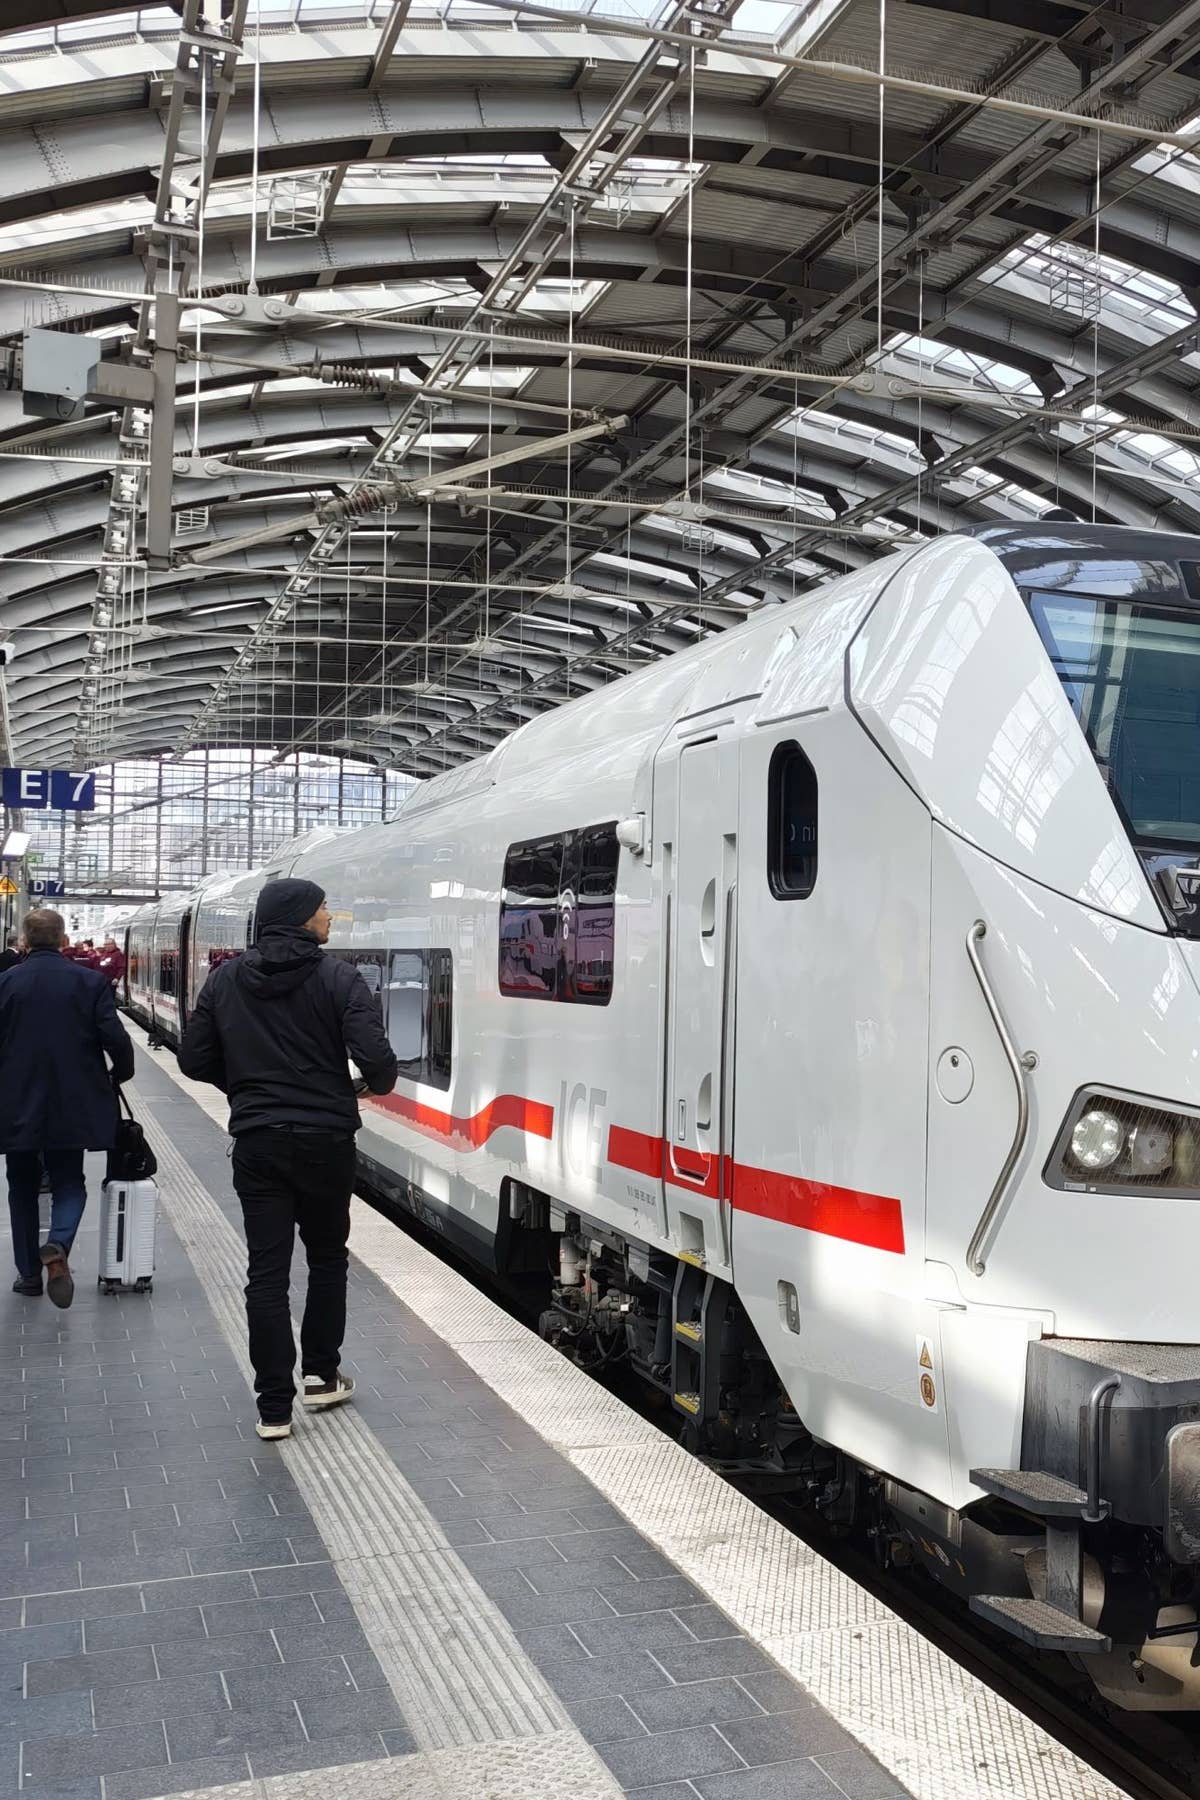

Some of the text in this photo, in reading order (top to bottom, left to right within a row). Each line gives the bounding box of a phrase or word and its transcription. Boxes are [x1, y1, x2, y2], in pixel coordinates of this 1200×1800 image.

[20, 770, 91, 802] E 7
[33, 880, 63, 893] D 7
[558, 1080, 607, 1185] ICE
